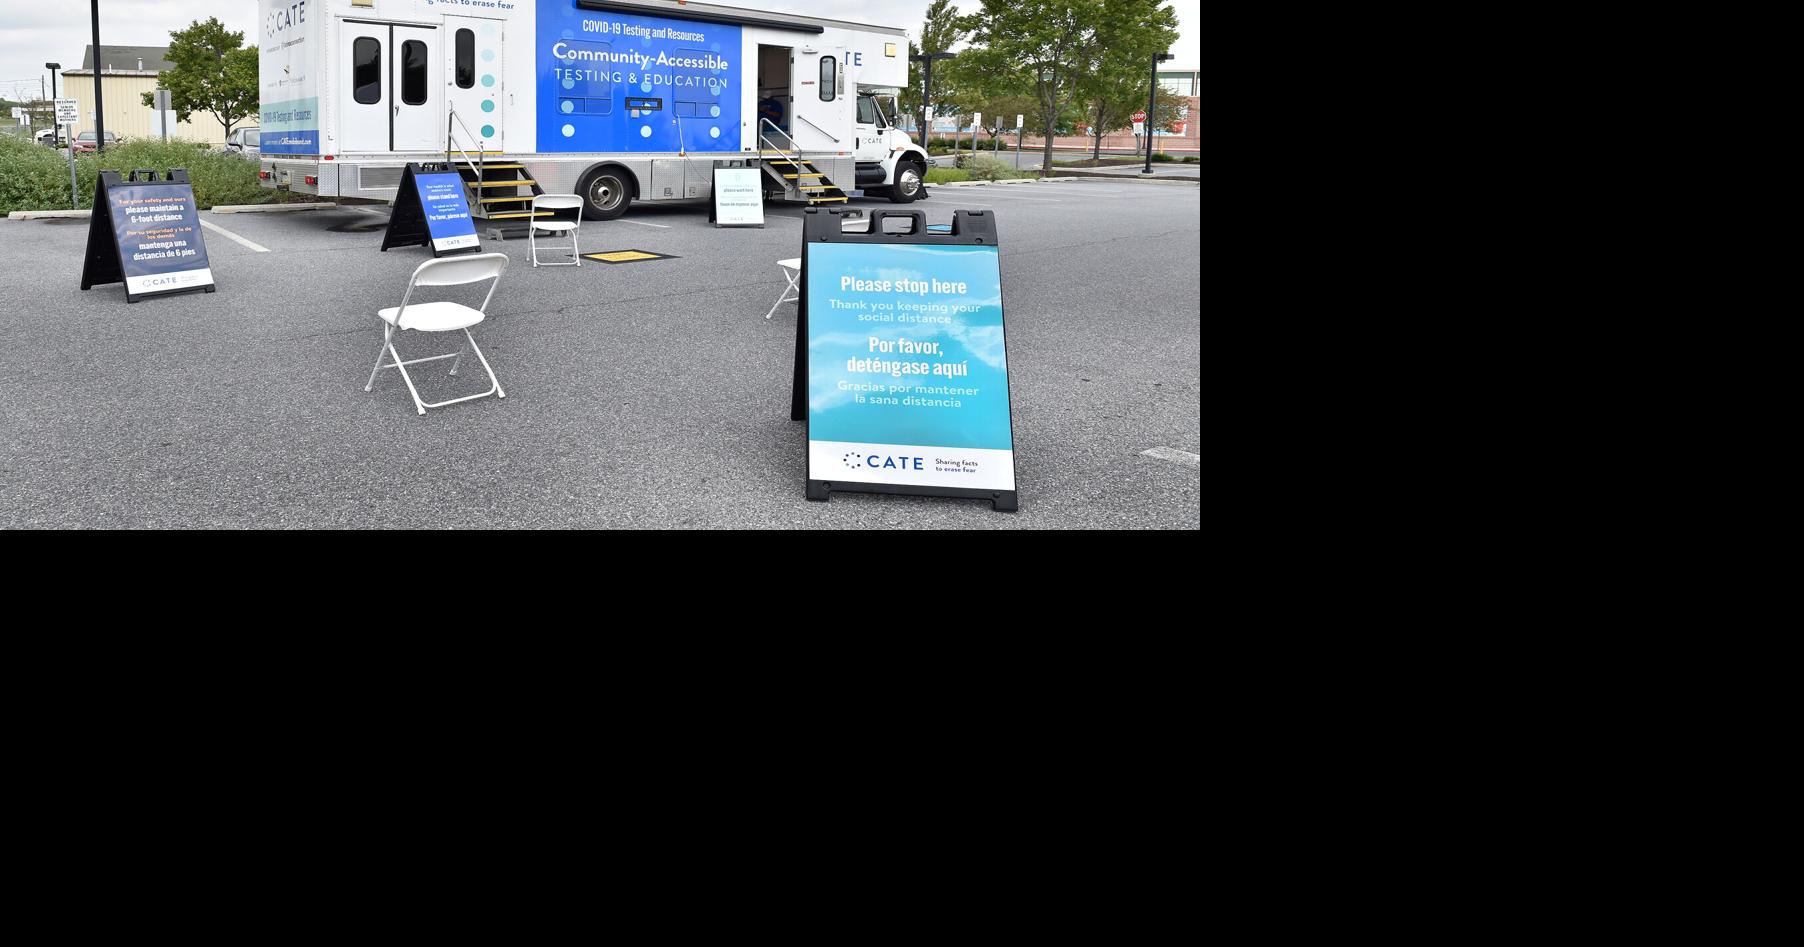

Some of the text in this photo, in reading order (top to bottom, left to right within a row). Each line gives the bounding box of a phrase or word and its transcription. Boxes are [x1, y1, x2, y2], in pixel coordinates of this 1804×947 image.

[497, 1, 514, 9] fear
[276, 1, 305, 31] CATE
[582, 20, 704, 42] COVID-19 Testing and Resources
[552, 42, 728, 70] Community-Accessible
[554, 68, 728, 88] TESTING & EDUCATION
[125, 206, 148, 214] please
[149, 204, 179, 212] maintain
[139, 241, 173, 250] mantenga
[133, 251, 166, 260] distancia
[181, 249, 196, 257] pies
[153, 277, 177, 285] CATE
[840, 276, 967, 296] Please stop here
[829, 299, 981, 314] Thank you keeping your
[858, 312, 952, 324] social distance
[869, 336, 944, 357] Por favor,
[847, 356, 968, 379] deténgase aquí
[837, 380, 980, 396] Gracias por mantener
[855, 393, 961, 408] la sana distancia
[866, 455, 924, 471] CATE
[935, 458, 961, 467] Sharing
